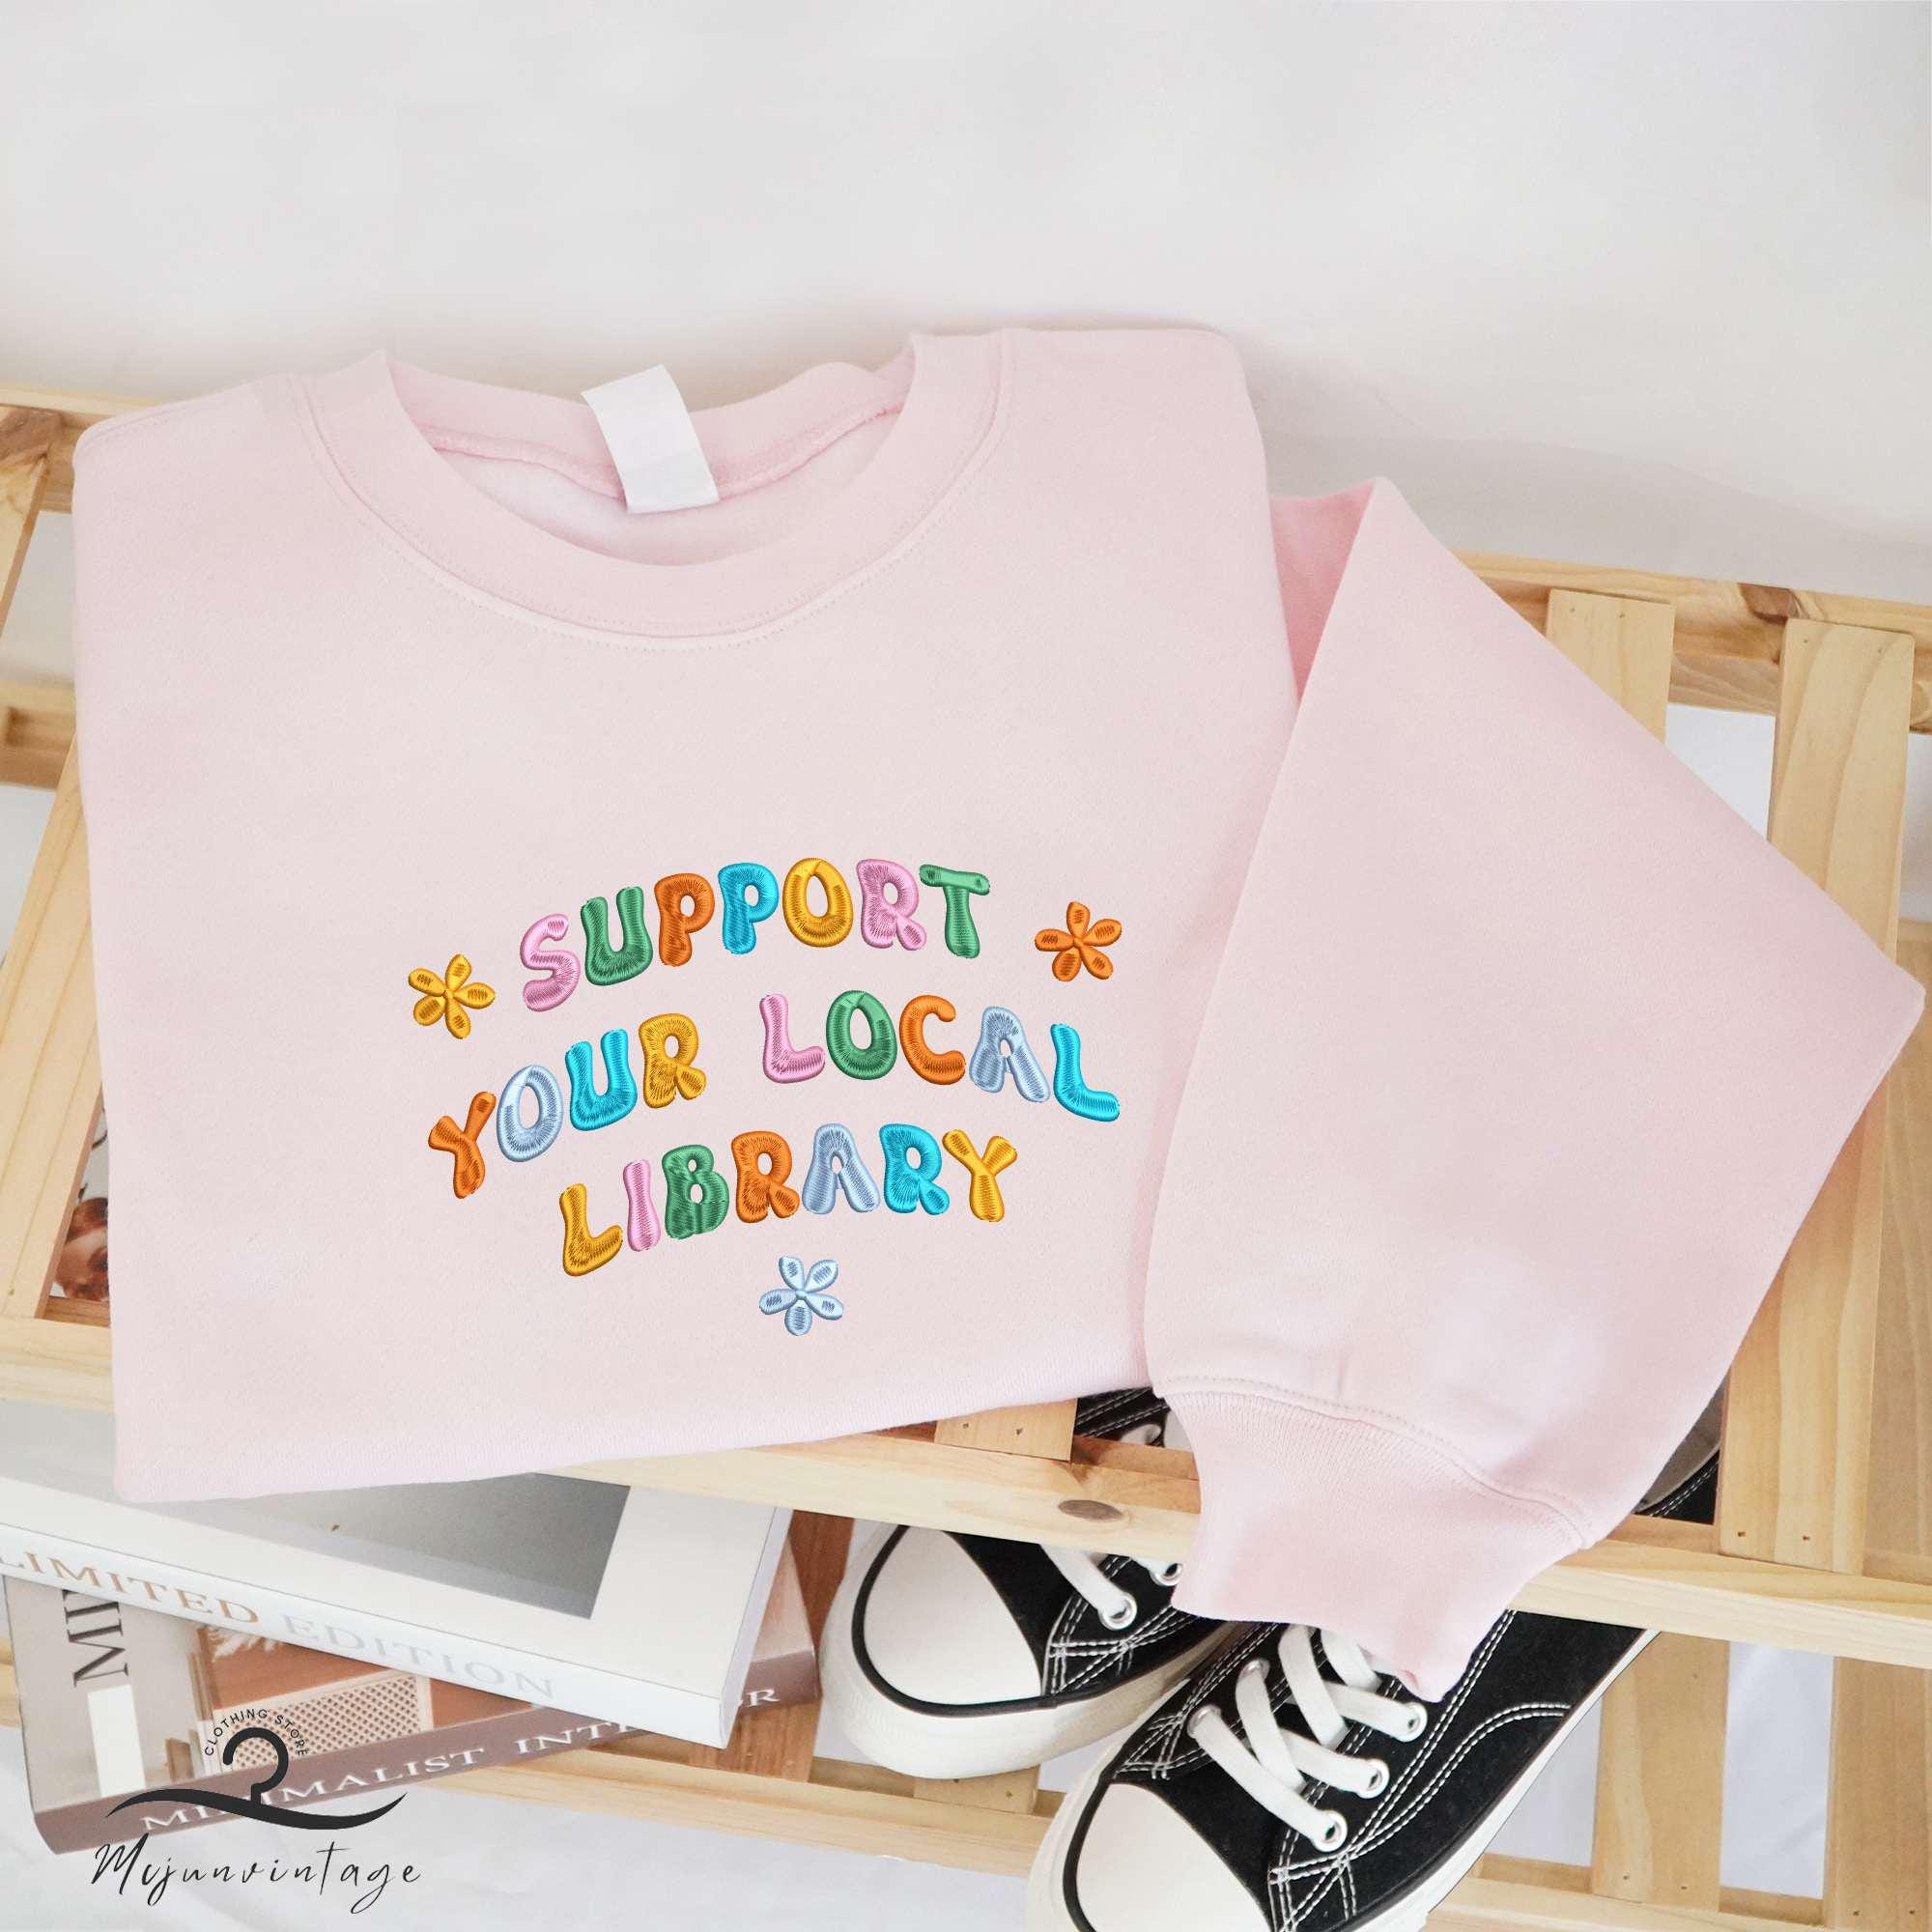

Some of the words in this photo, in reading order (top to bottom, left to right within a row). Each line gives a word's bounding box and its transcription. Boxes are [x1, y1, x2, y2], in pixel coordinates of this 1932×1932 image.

[519, 856, 990, 1012] SUPPORT
[427, 1010, 708, 1201] YOUR
[759, 989, 1121, 1122] LOCAL
[557, 1122, 1019, 1278] LIBRARY
[282, 1614, 554, 1700] EDITION
